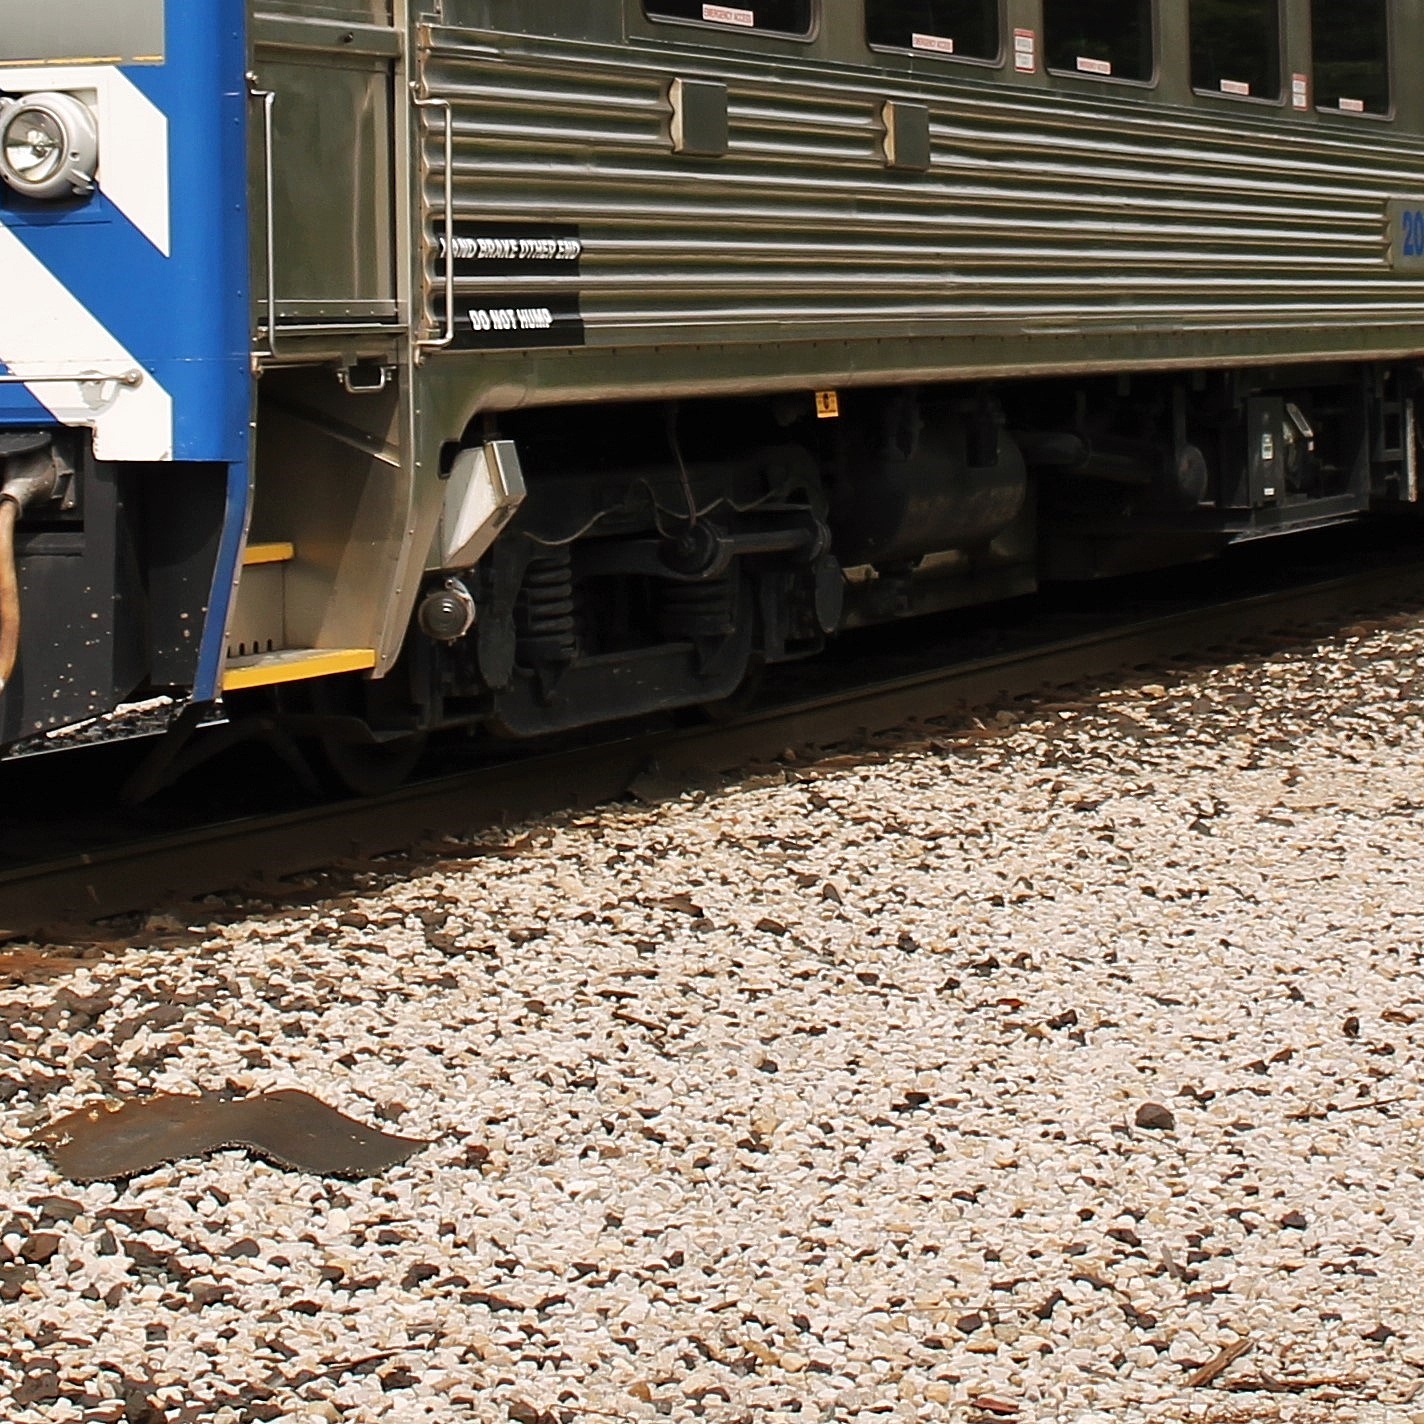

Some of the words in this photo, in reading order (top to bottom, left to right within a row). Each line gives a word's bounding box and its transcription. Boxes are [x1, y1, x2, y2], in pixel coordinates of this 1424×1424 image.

[476, 238, 518, 259] BRAKE
[519, 239, 557, 259] OTHER
[555, 240, 581, 260] END
[469, 310, 490, 331] DO
[489, 309, 516, 330] NOT
[516, 308, 553, 329] HUMP
